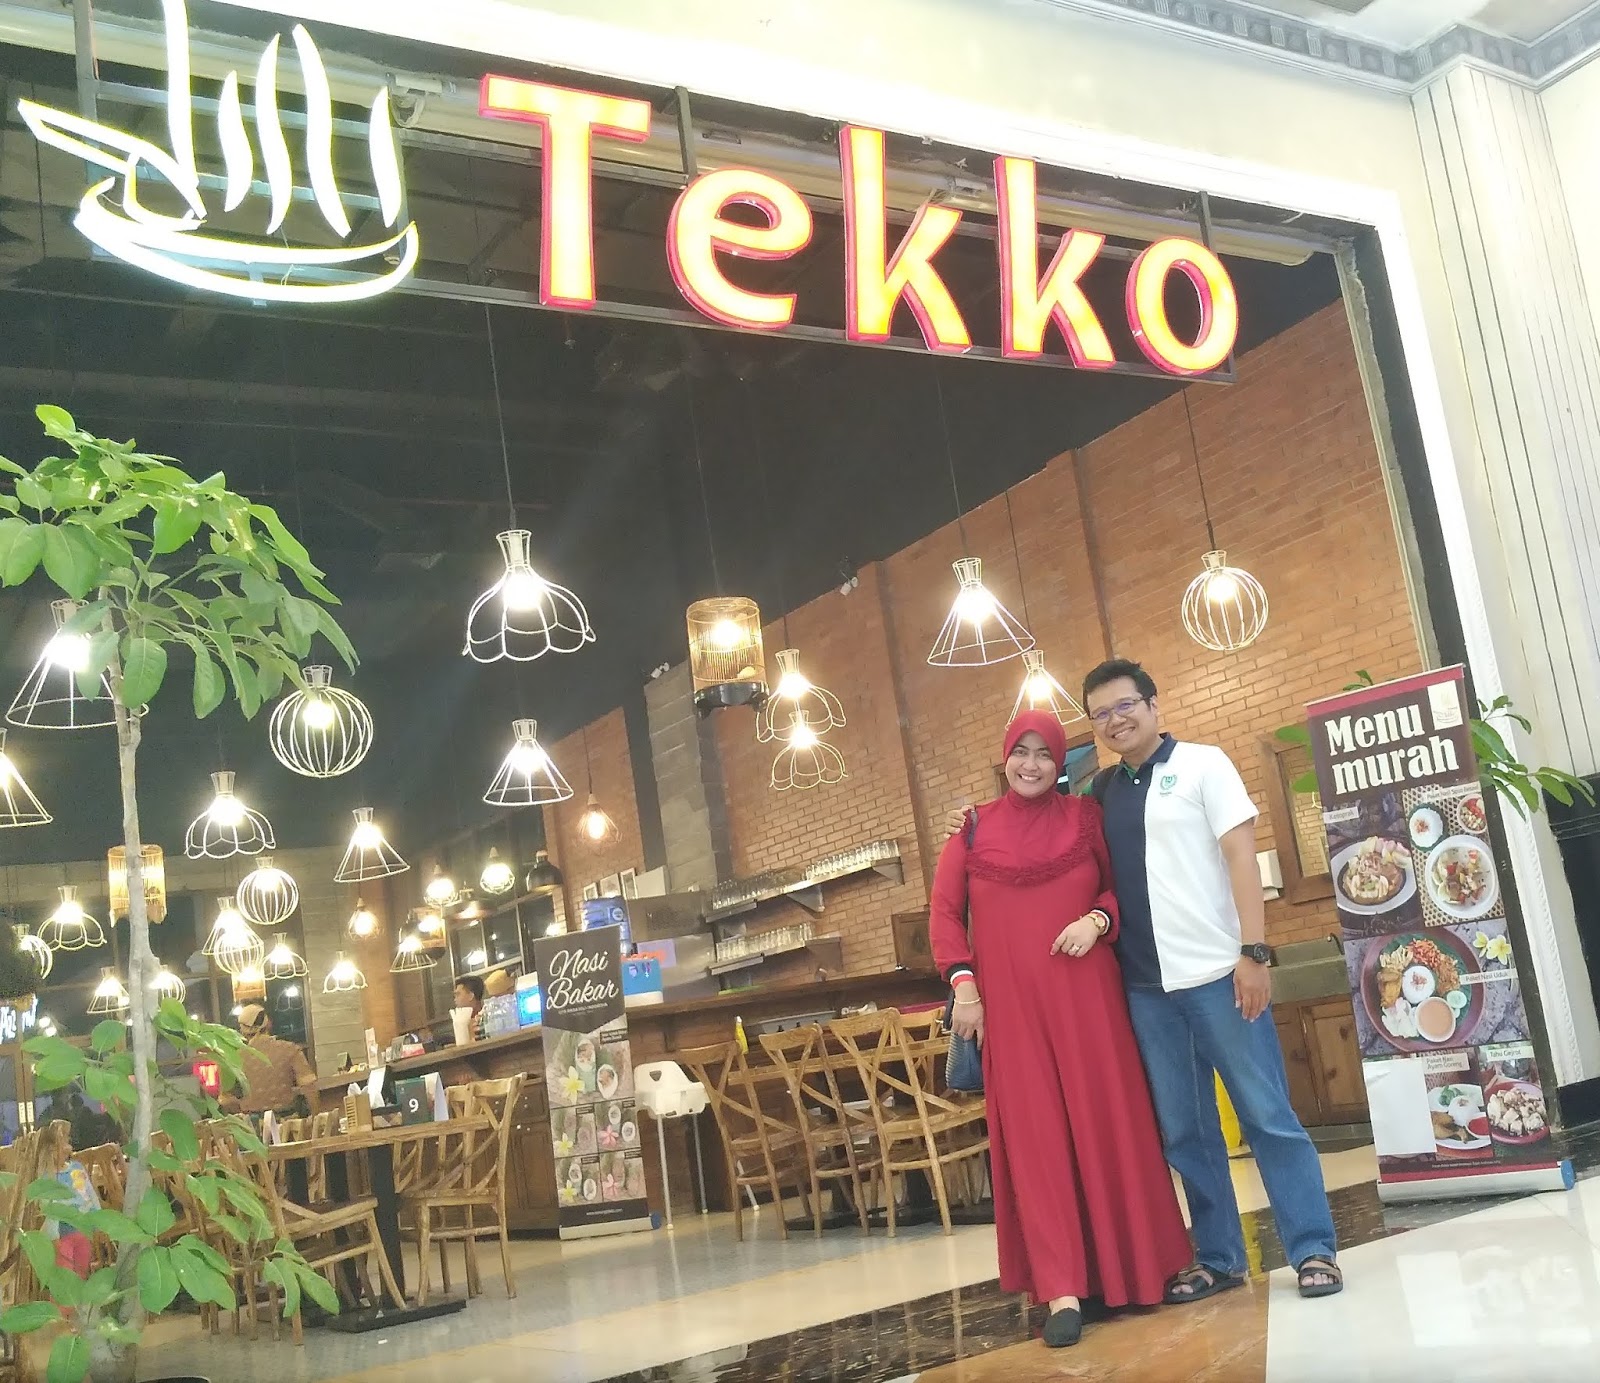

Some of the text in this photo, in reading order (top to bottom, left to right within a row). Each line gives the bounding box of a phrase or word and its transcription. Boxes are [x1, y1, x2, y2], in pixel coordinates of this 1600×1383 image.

[479, 73, 1239, 376] Tekko
[1324, 703, 1425, 757] Menu
[1331, 735, 1460, 795] murah
[549, 948, 608, 979] Nasi
[546, 977, 619, 1010] Bakar
[409, 1098, 419, 1113] 9
